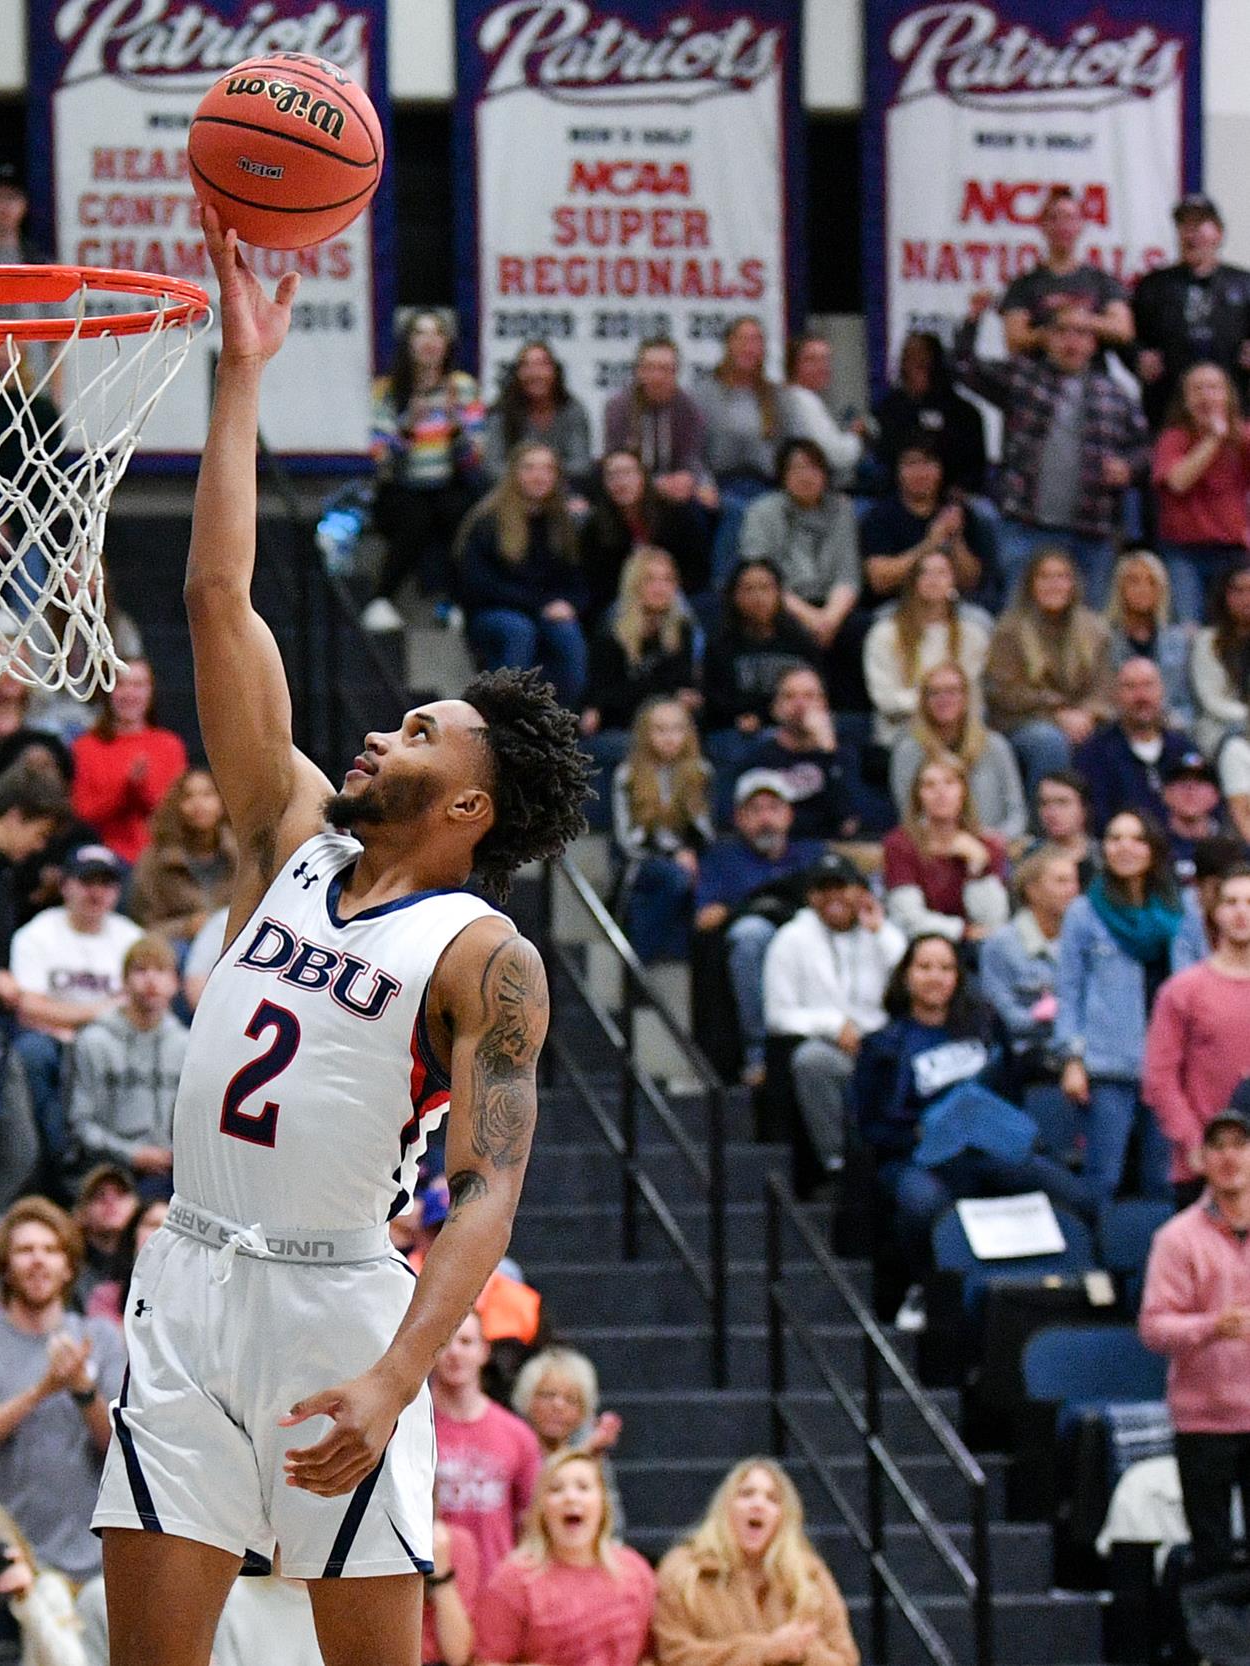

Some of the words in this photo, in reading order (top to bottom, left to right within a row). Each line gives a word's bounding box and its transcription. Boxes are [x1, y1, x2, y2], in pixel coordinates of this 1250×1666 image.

[477, 0, 780, 92] Patriots
[889, 3, 1185, 97] Patriots
[224, 76, 347, 142] Wilson
[568, 159, 692, 197] NCAA
[961, 181, 1110, 227] NCA
[553, 206, 711, 248] SUPER
[497, 255, 766, 299] REGIONALS
[234, 916, 402, 1021] DBU
[220, 998, 301, 1149] 2
